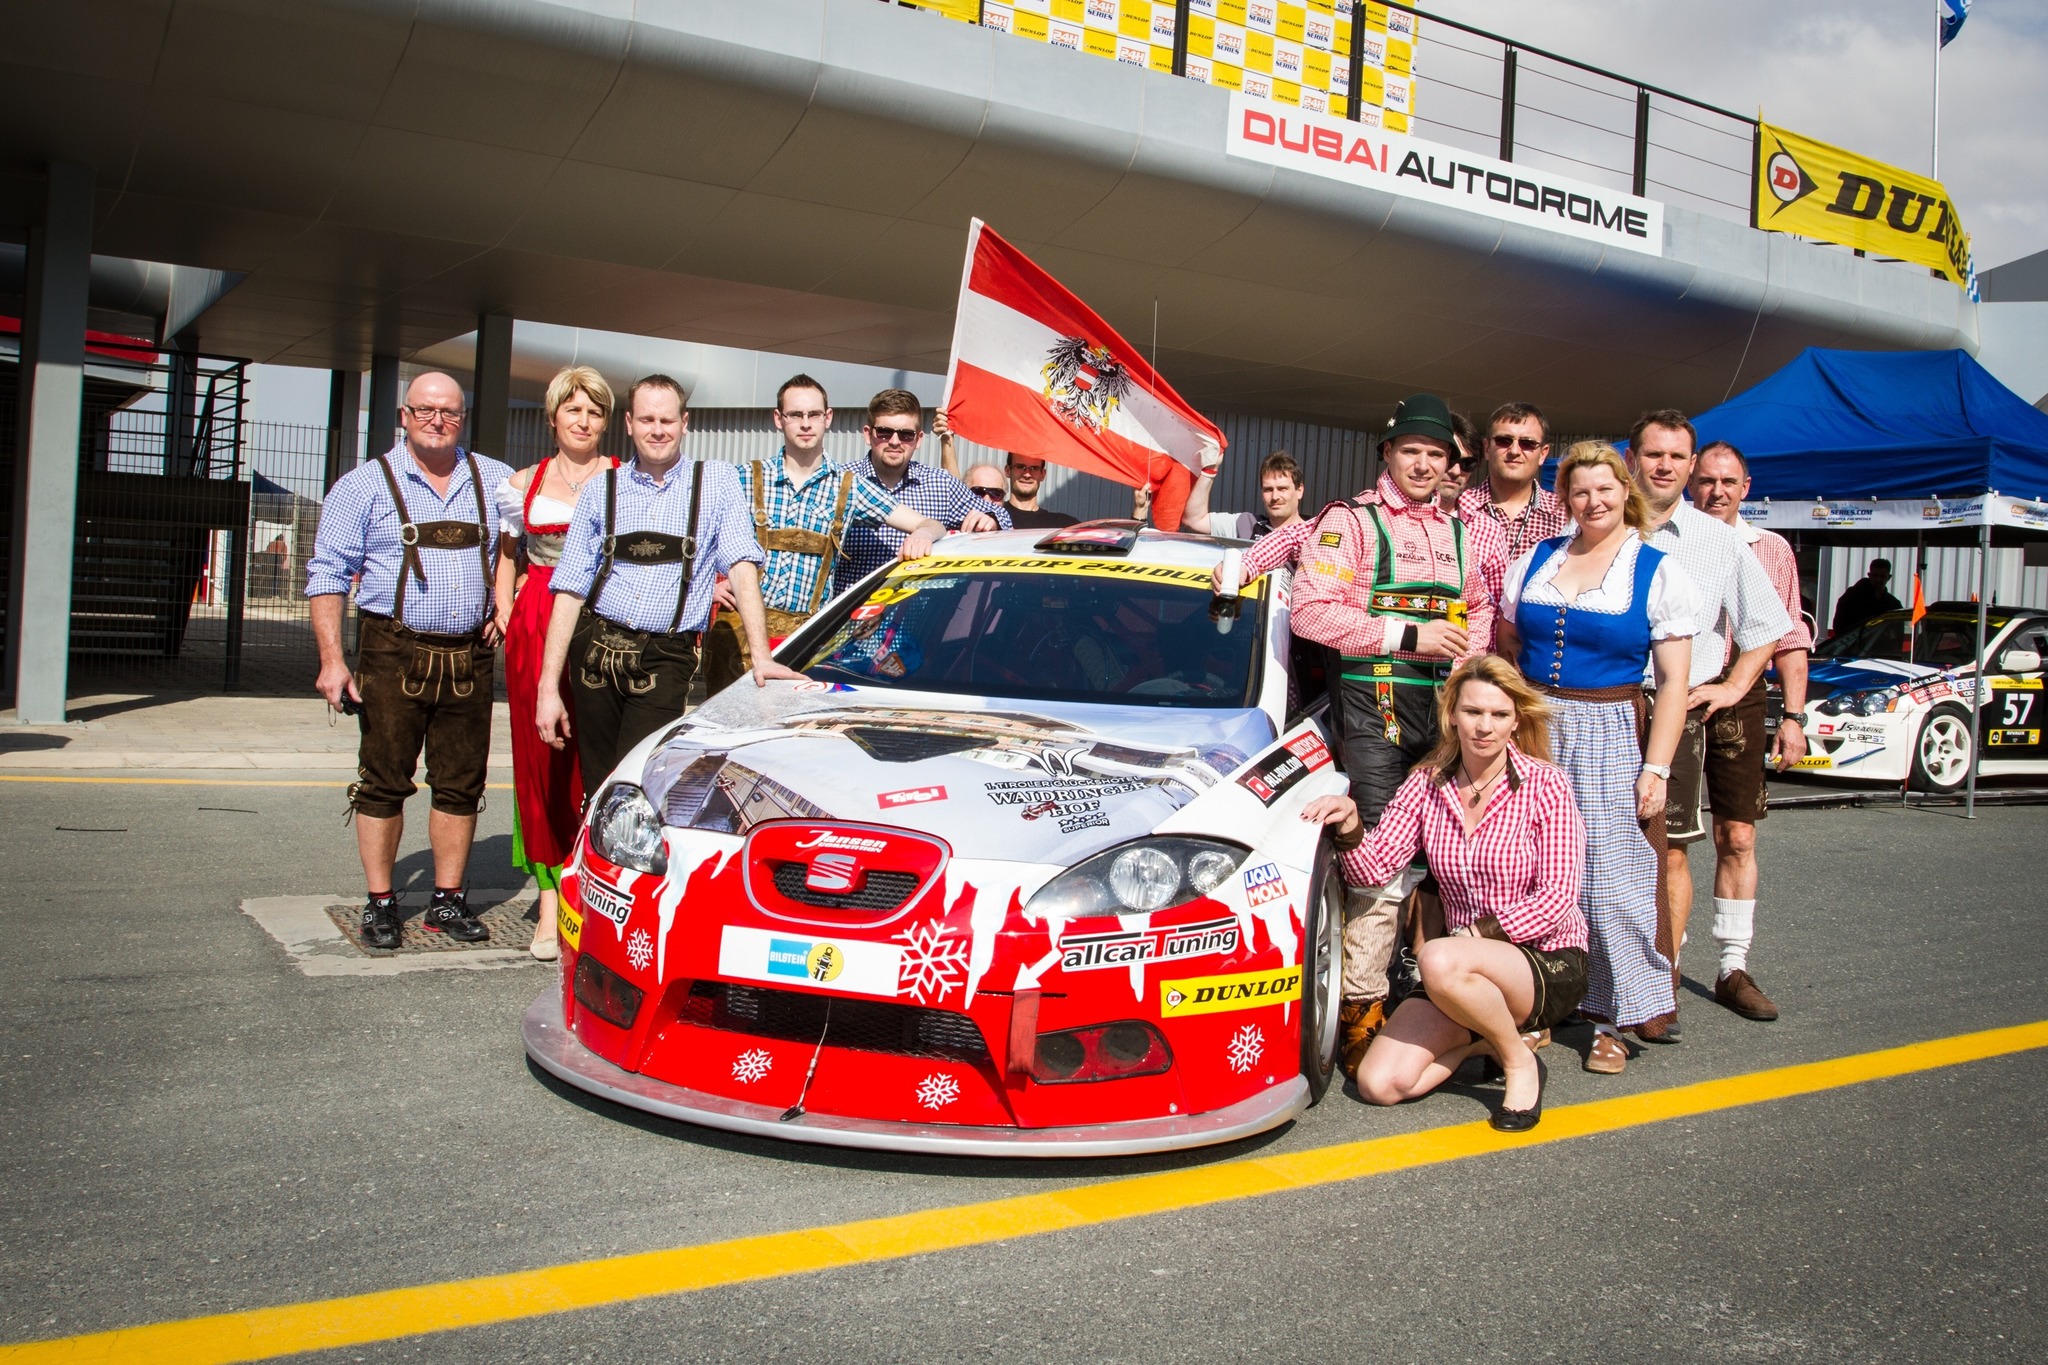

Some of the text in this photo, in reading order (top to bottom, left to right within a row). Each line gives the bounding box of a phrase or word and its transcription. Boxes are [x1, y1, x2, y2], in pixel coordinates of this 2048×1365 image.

[1243, 109, 1648, 238] DUBAI AUTODROME
[925, 560, 1212, 583] DUNLOP 24H DUB
[2002, 693, 2034, 725] 57
[987, 782, 1149, 805] WAIDRINGER
[995, 780, 1051, 789] TIROLER
[1050, 800, 1100, 817] HOF
[1062, 818, 1110, 833] SUPERIOR
[795, 830, 887, 848] Jansen
[818, 842, 882, 853] COMPETITION
[1244, 863, 1280, 889] LIQUI
[1247, 879, 1286, 906] MOLY
[769, 951, 806, 965] BILSTEIN
[1192, 975, 1299, 1003] DUNLOP
